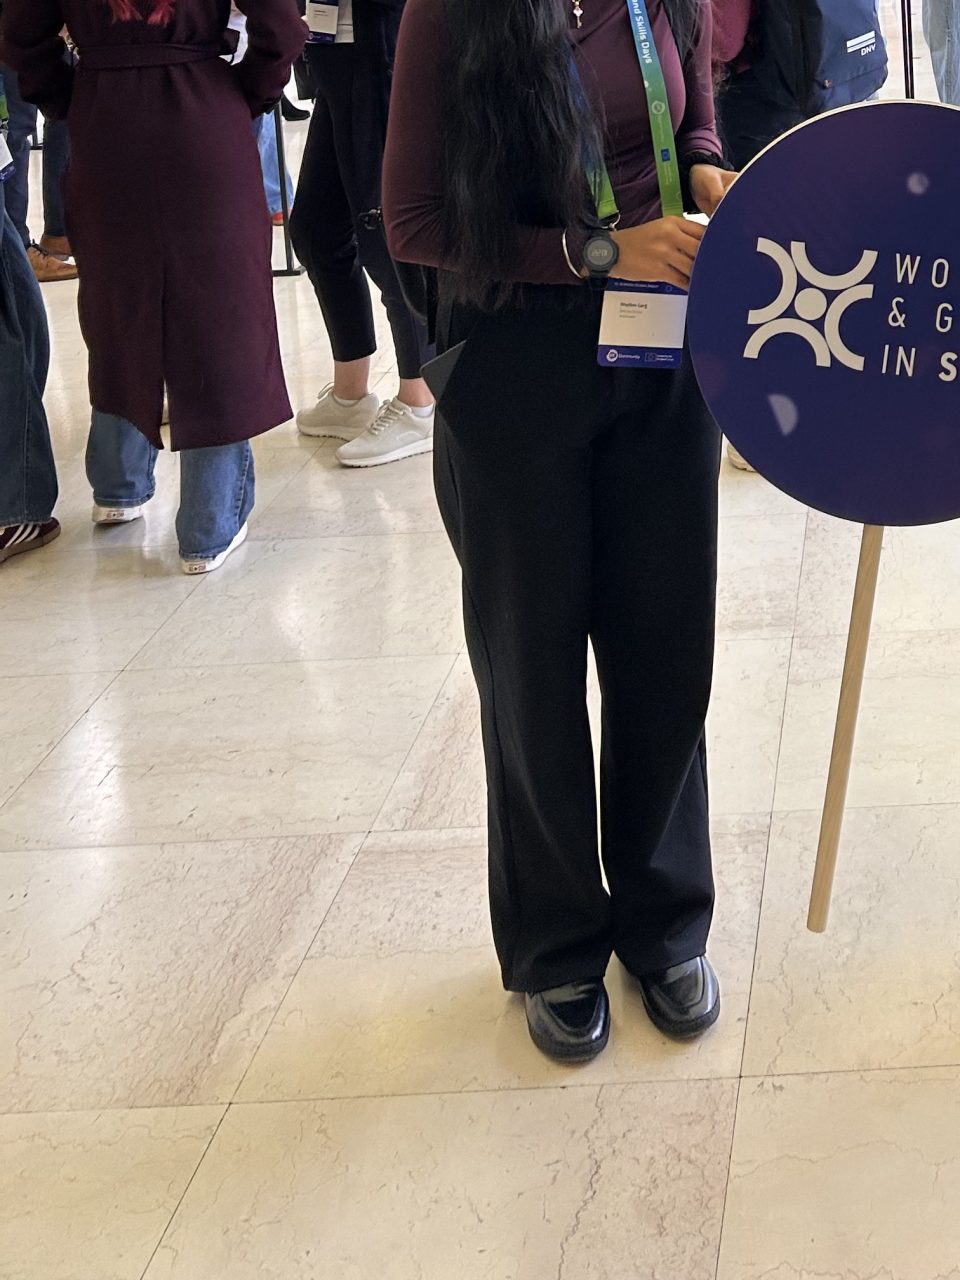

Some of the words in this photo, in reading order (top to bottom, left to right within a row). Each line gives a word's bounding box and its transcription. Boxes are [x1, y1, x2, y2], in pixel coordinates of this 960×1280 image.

[635, 15, 648, 41] Skills
[641, 41, 653, 64] Days
[860, 43, 876, 56] DNV
[888, 296, 907, 328] &
[881, 343, 917, 378] IN
